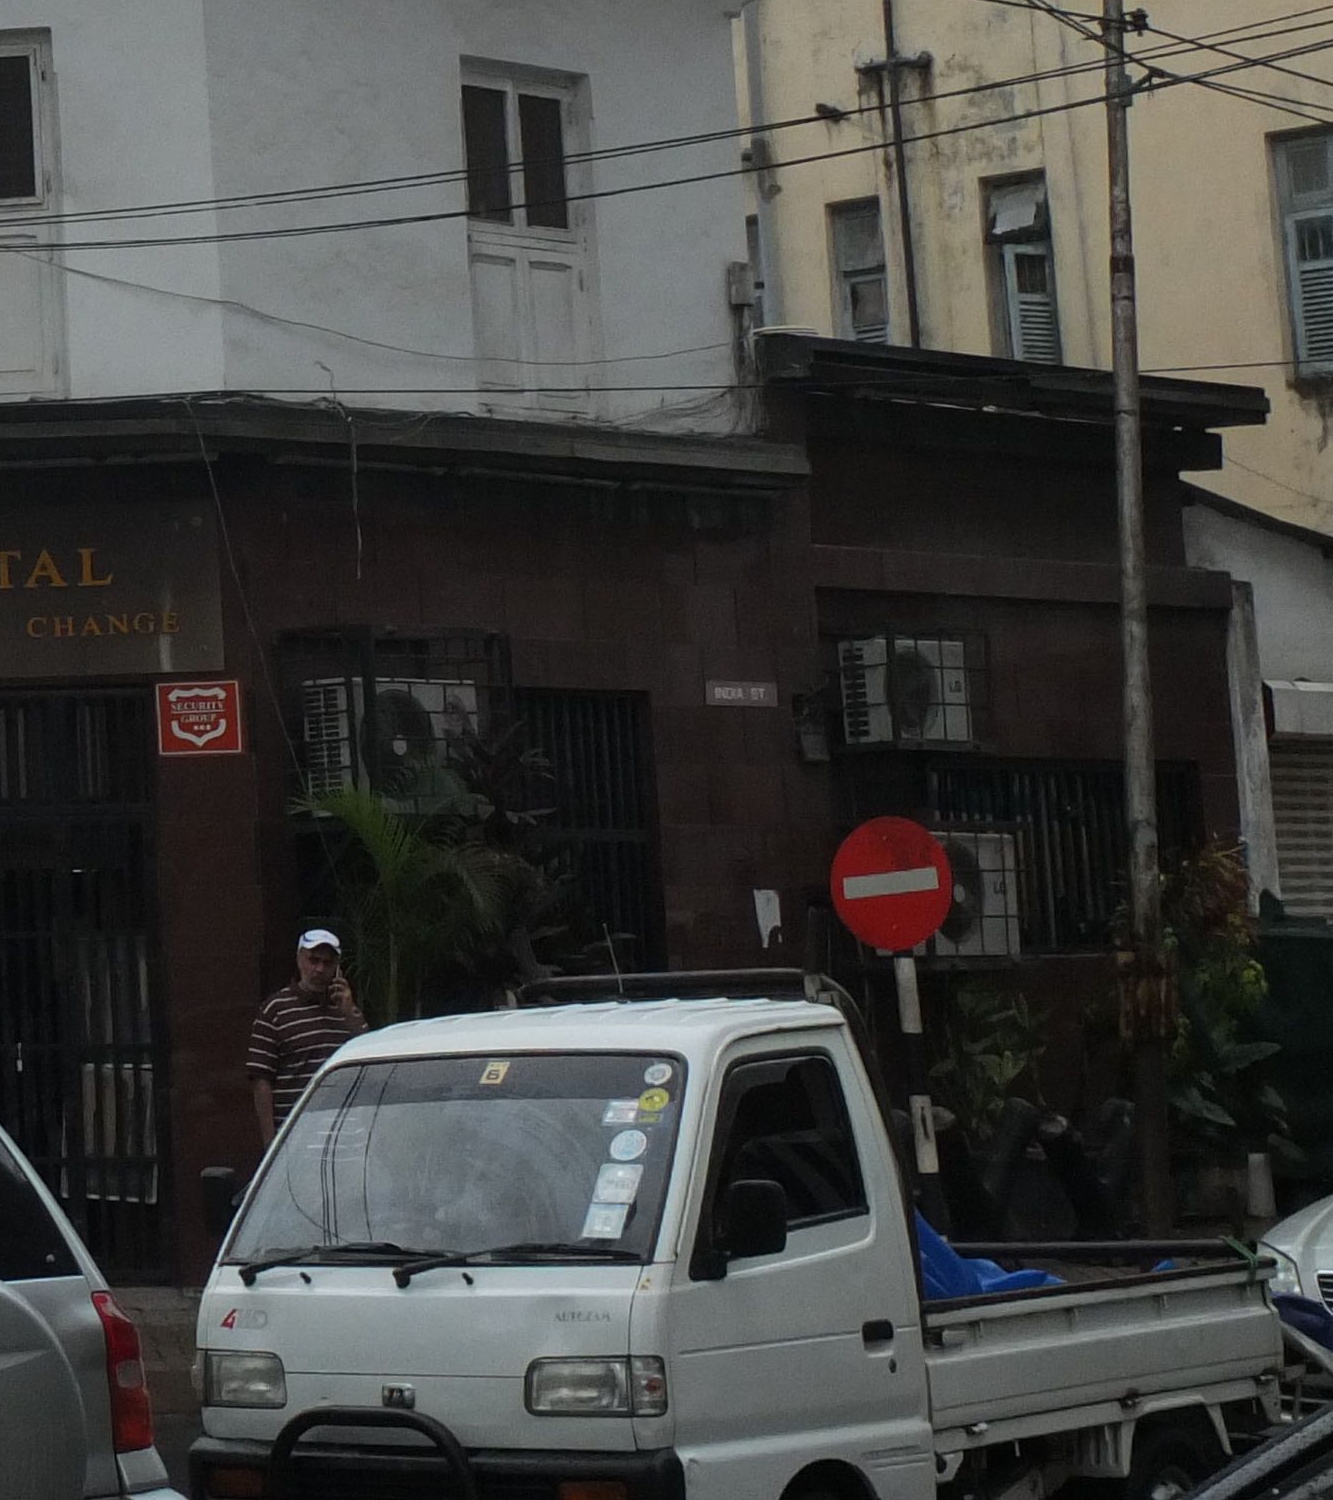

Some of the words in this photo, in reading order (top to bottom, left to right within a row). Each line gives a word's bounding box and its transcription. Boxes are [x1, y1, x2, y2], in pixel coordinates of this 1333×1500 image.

[26, 611, 182, 640] CHANGE
[171, 701, 225, 711] SECURITY
[180, 713, 217, 723] GROUP
